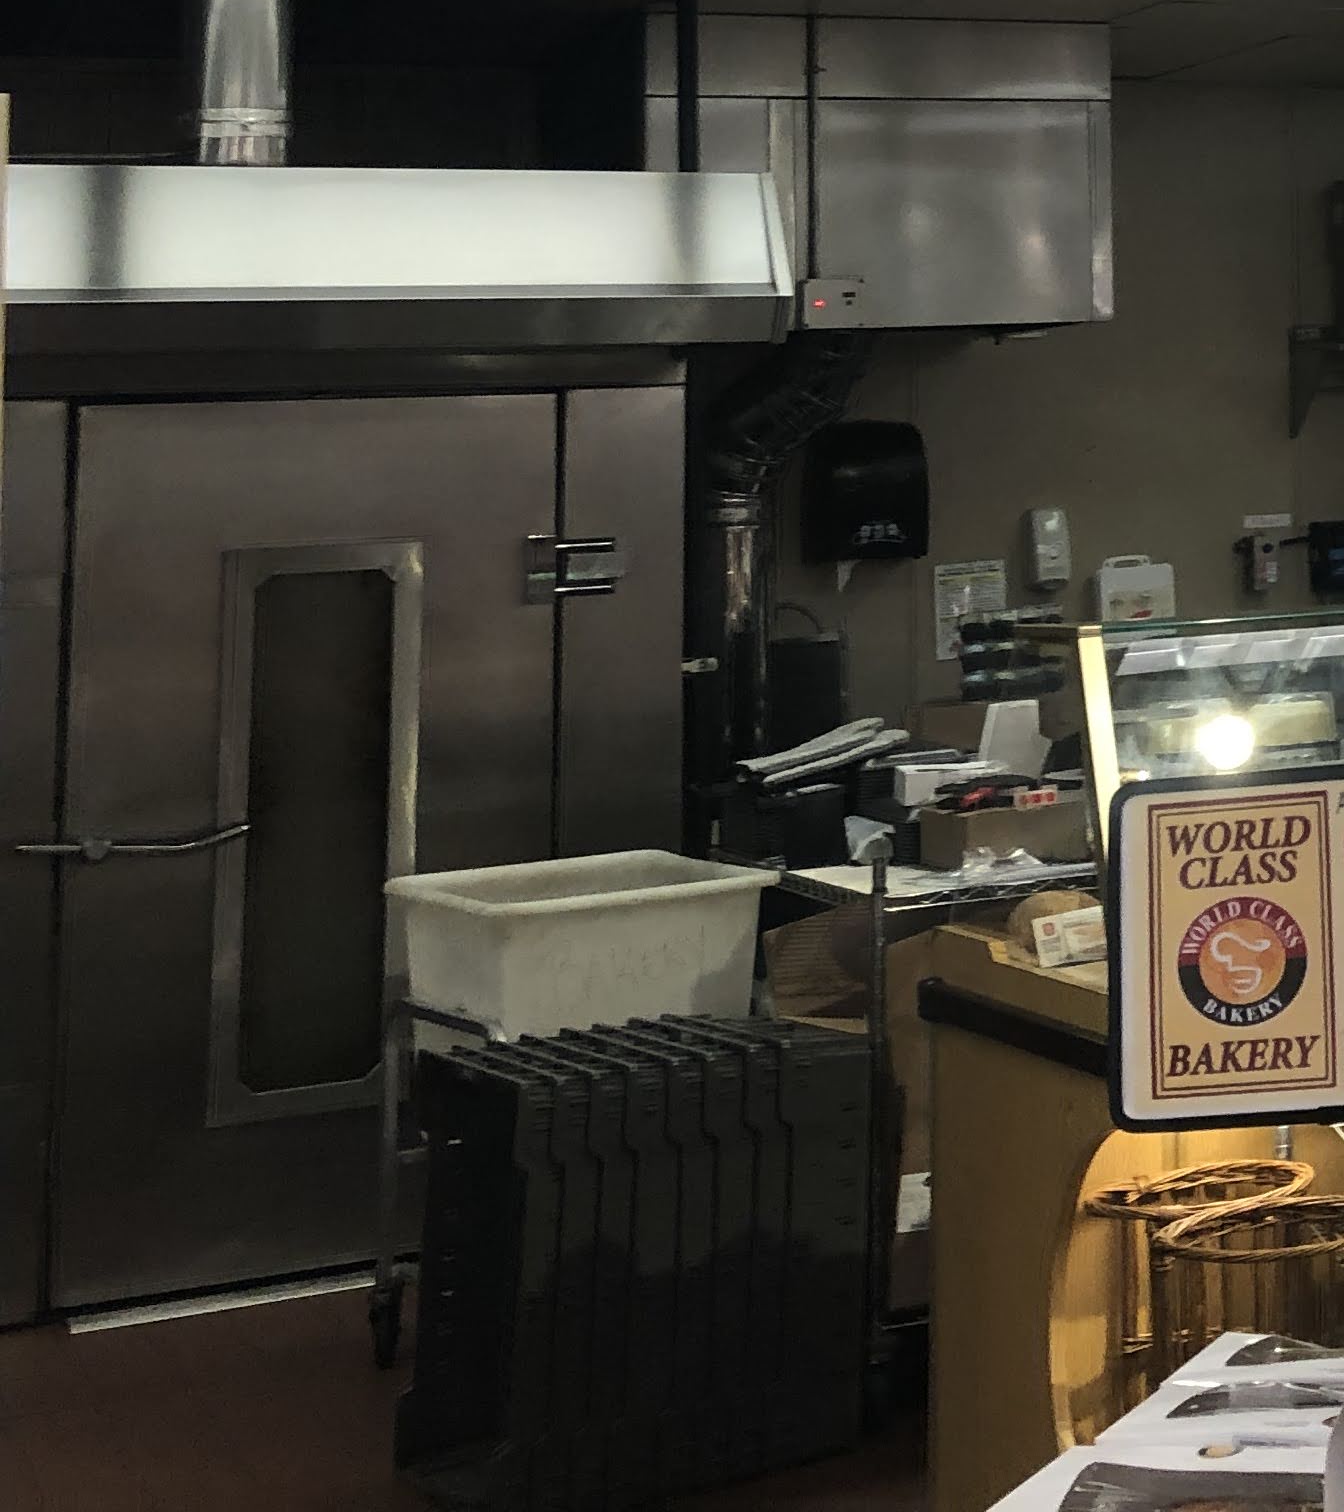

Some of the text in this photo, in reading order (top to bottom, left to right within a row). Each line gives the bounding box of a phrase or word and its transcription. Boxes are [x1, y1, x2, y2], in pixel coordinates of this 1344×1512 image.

[1166, 815, 1311, 857] WORLD
[1179, 850, 1298, 889] CLASS
[1181, 900, 1300, 955] WORLD CLASS
[1202, 995, 1284, 1025] BAKERY
[1166, 1034, 1321, 1078] BAKERY
